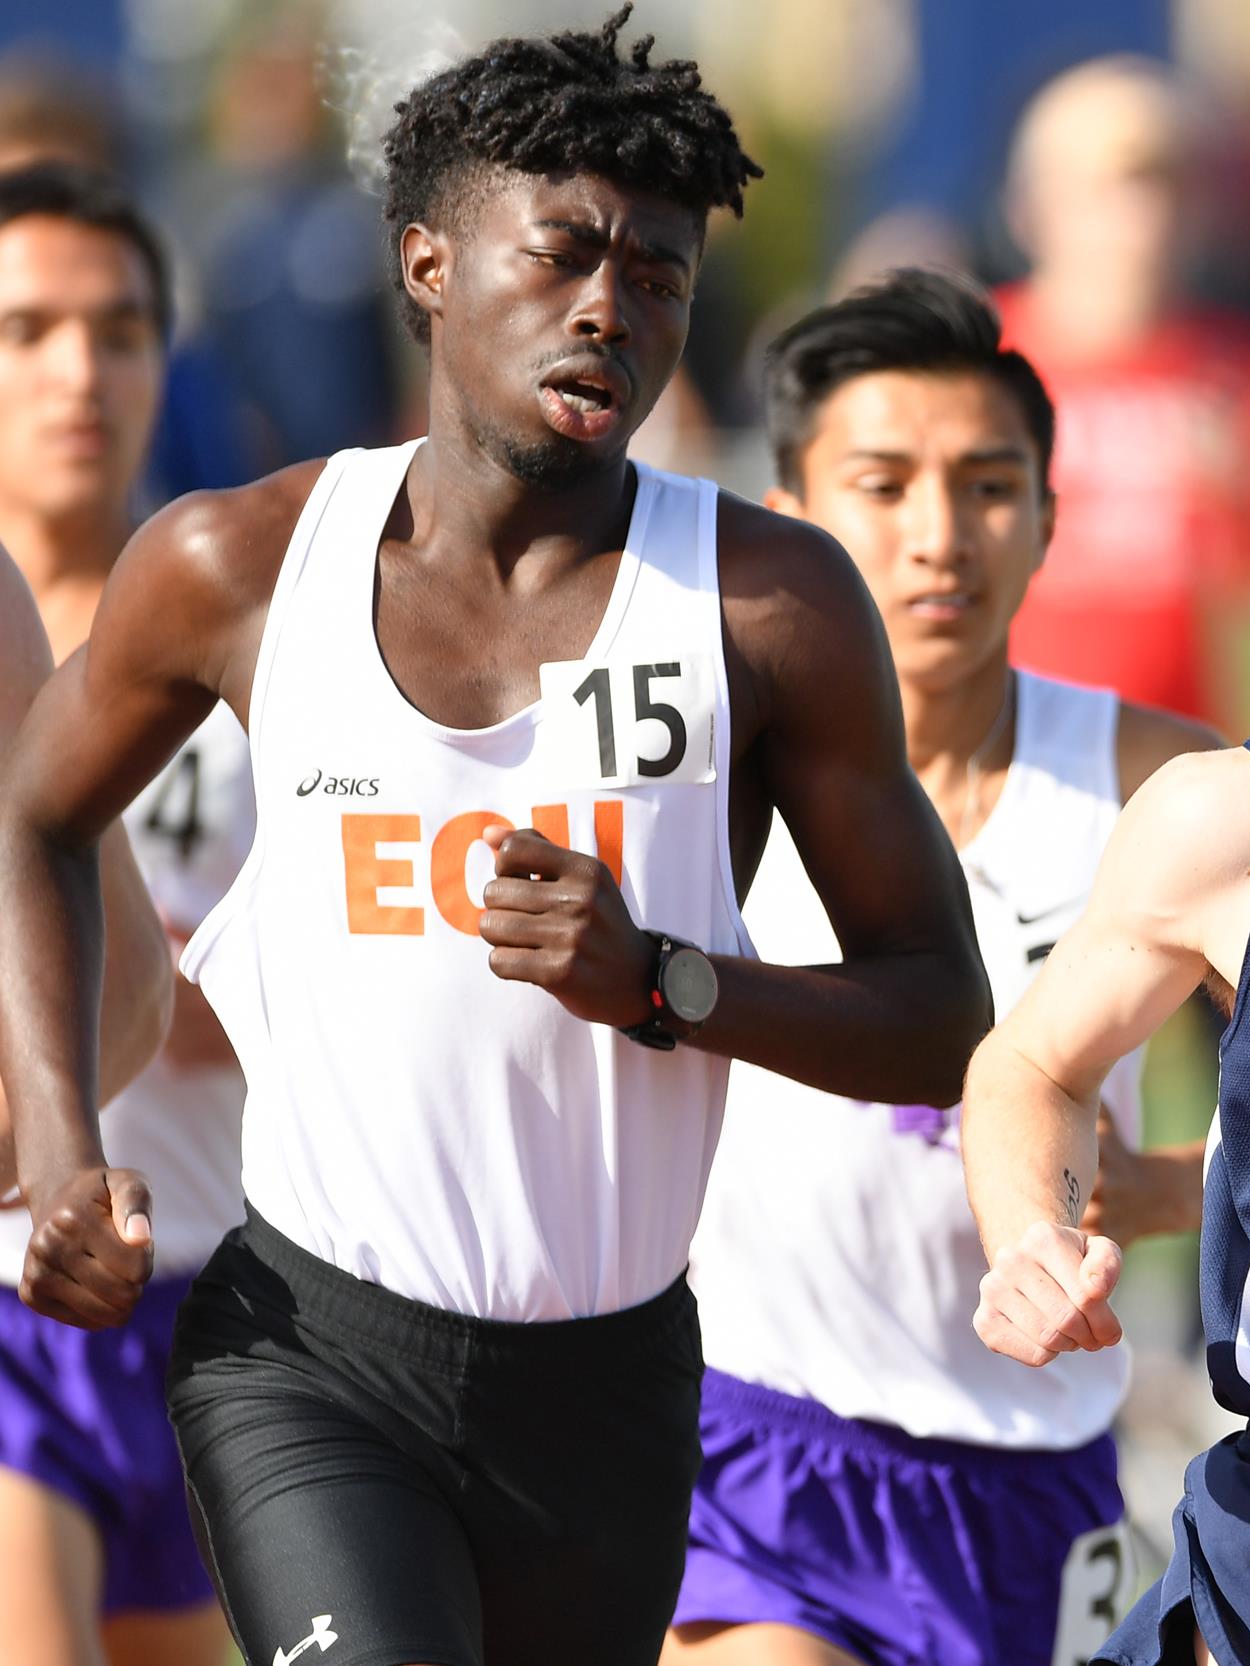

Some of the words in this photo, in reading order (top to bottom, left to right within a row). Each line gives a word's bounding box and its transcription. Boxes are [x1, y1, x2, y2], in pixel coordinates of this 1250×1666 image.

[572, 661, 688, 778] 15
[146, 749, 207, 866] 4
[323, 776, 380, 796] asics
